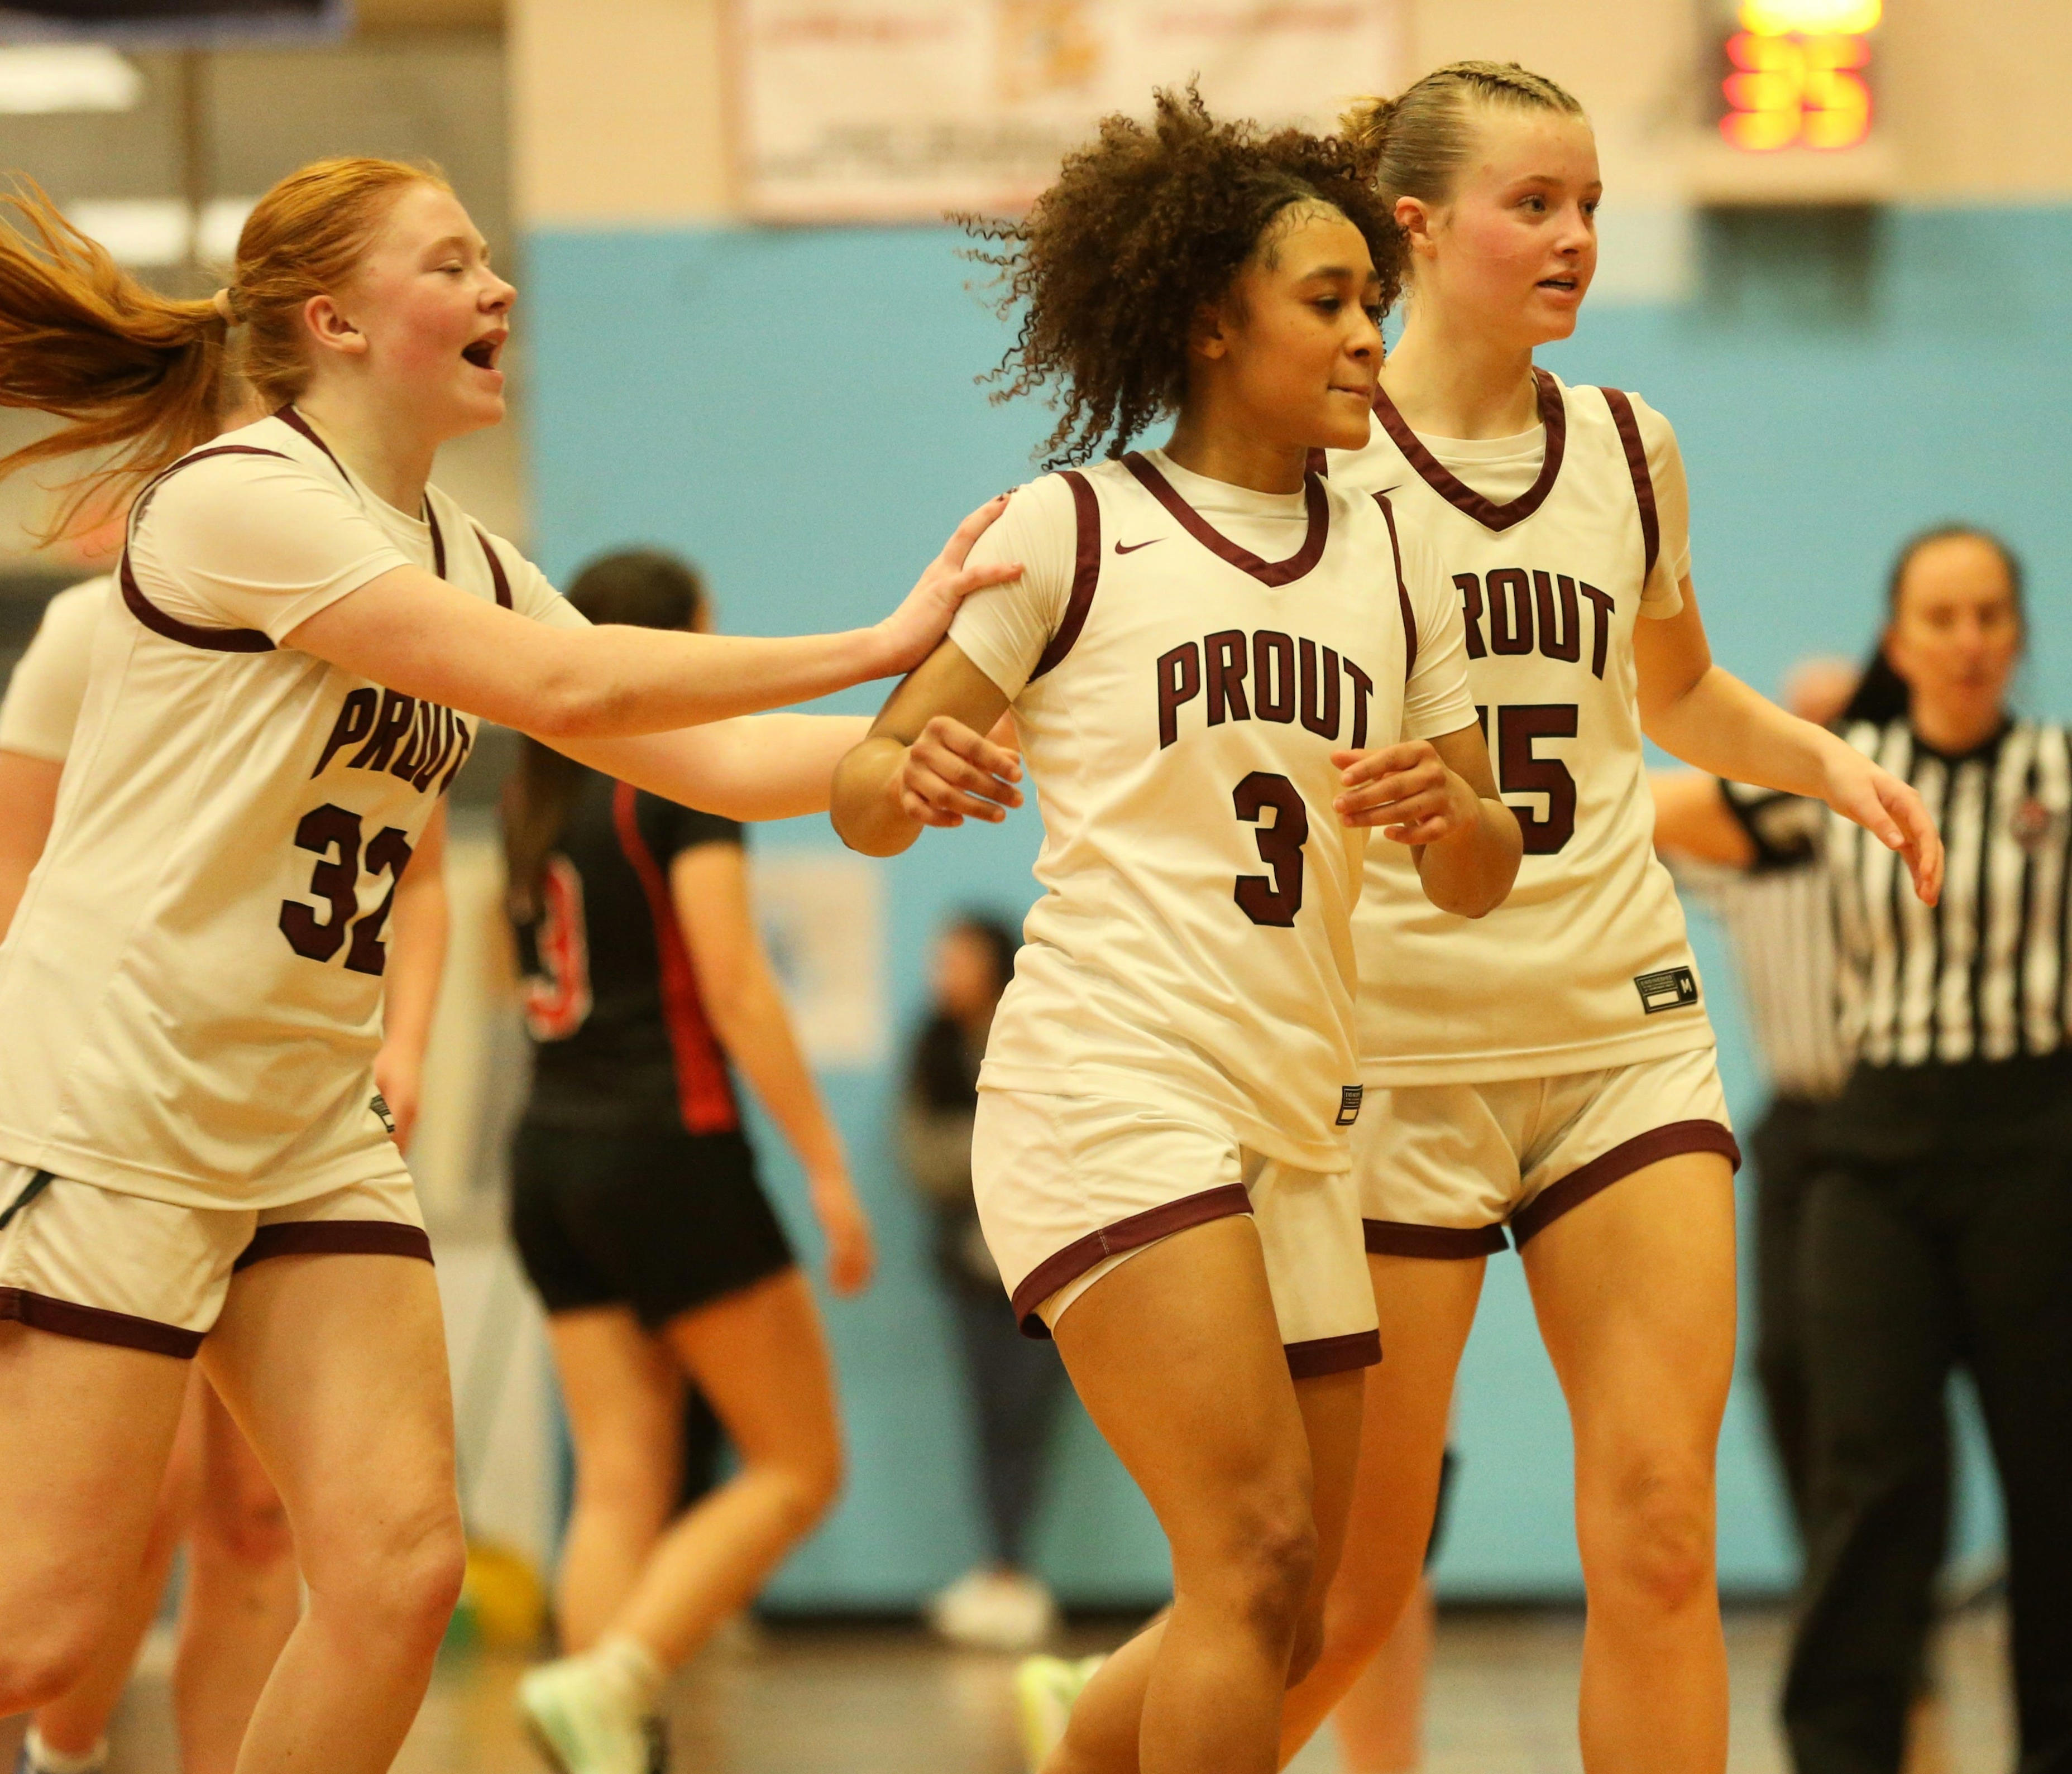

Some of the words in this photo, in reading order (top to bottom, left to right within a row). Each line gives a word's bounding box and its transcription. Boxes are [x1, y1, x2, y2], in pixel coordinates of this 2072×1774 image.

[1157, 629, 1374, 751] PROUT
[1452, 568, 1616, 681] ROUT
[309, 687, 470, 797] PROUT
[1475, 703, 1579, 855] 5
[279, 802, 413, 976] 32
[1232, 770, 1309, 928] 3
